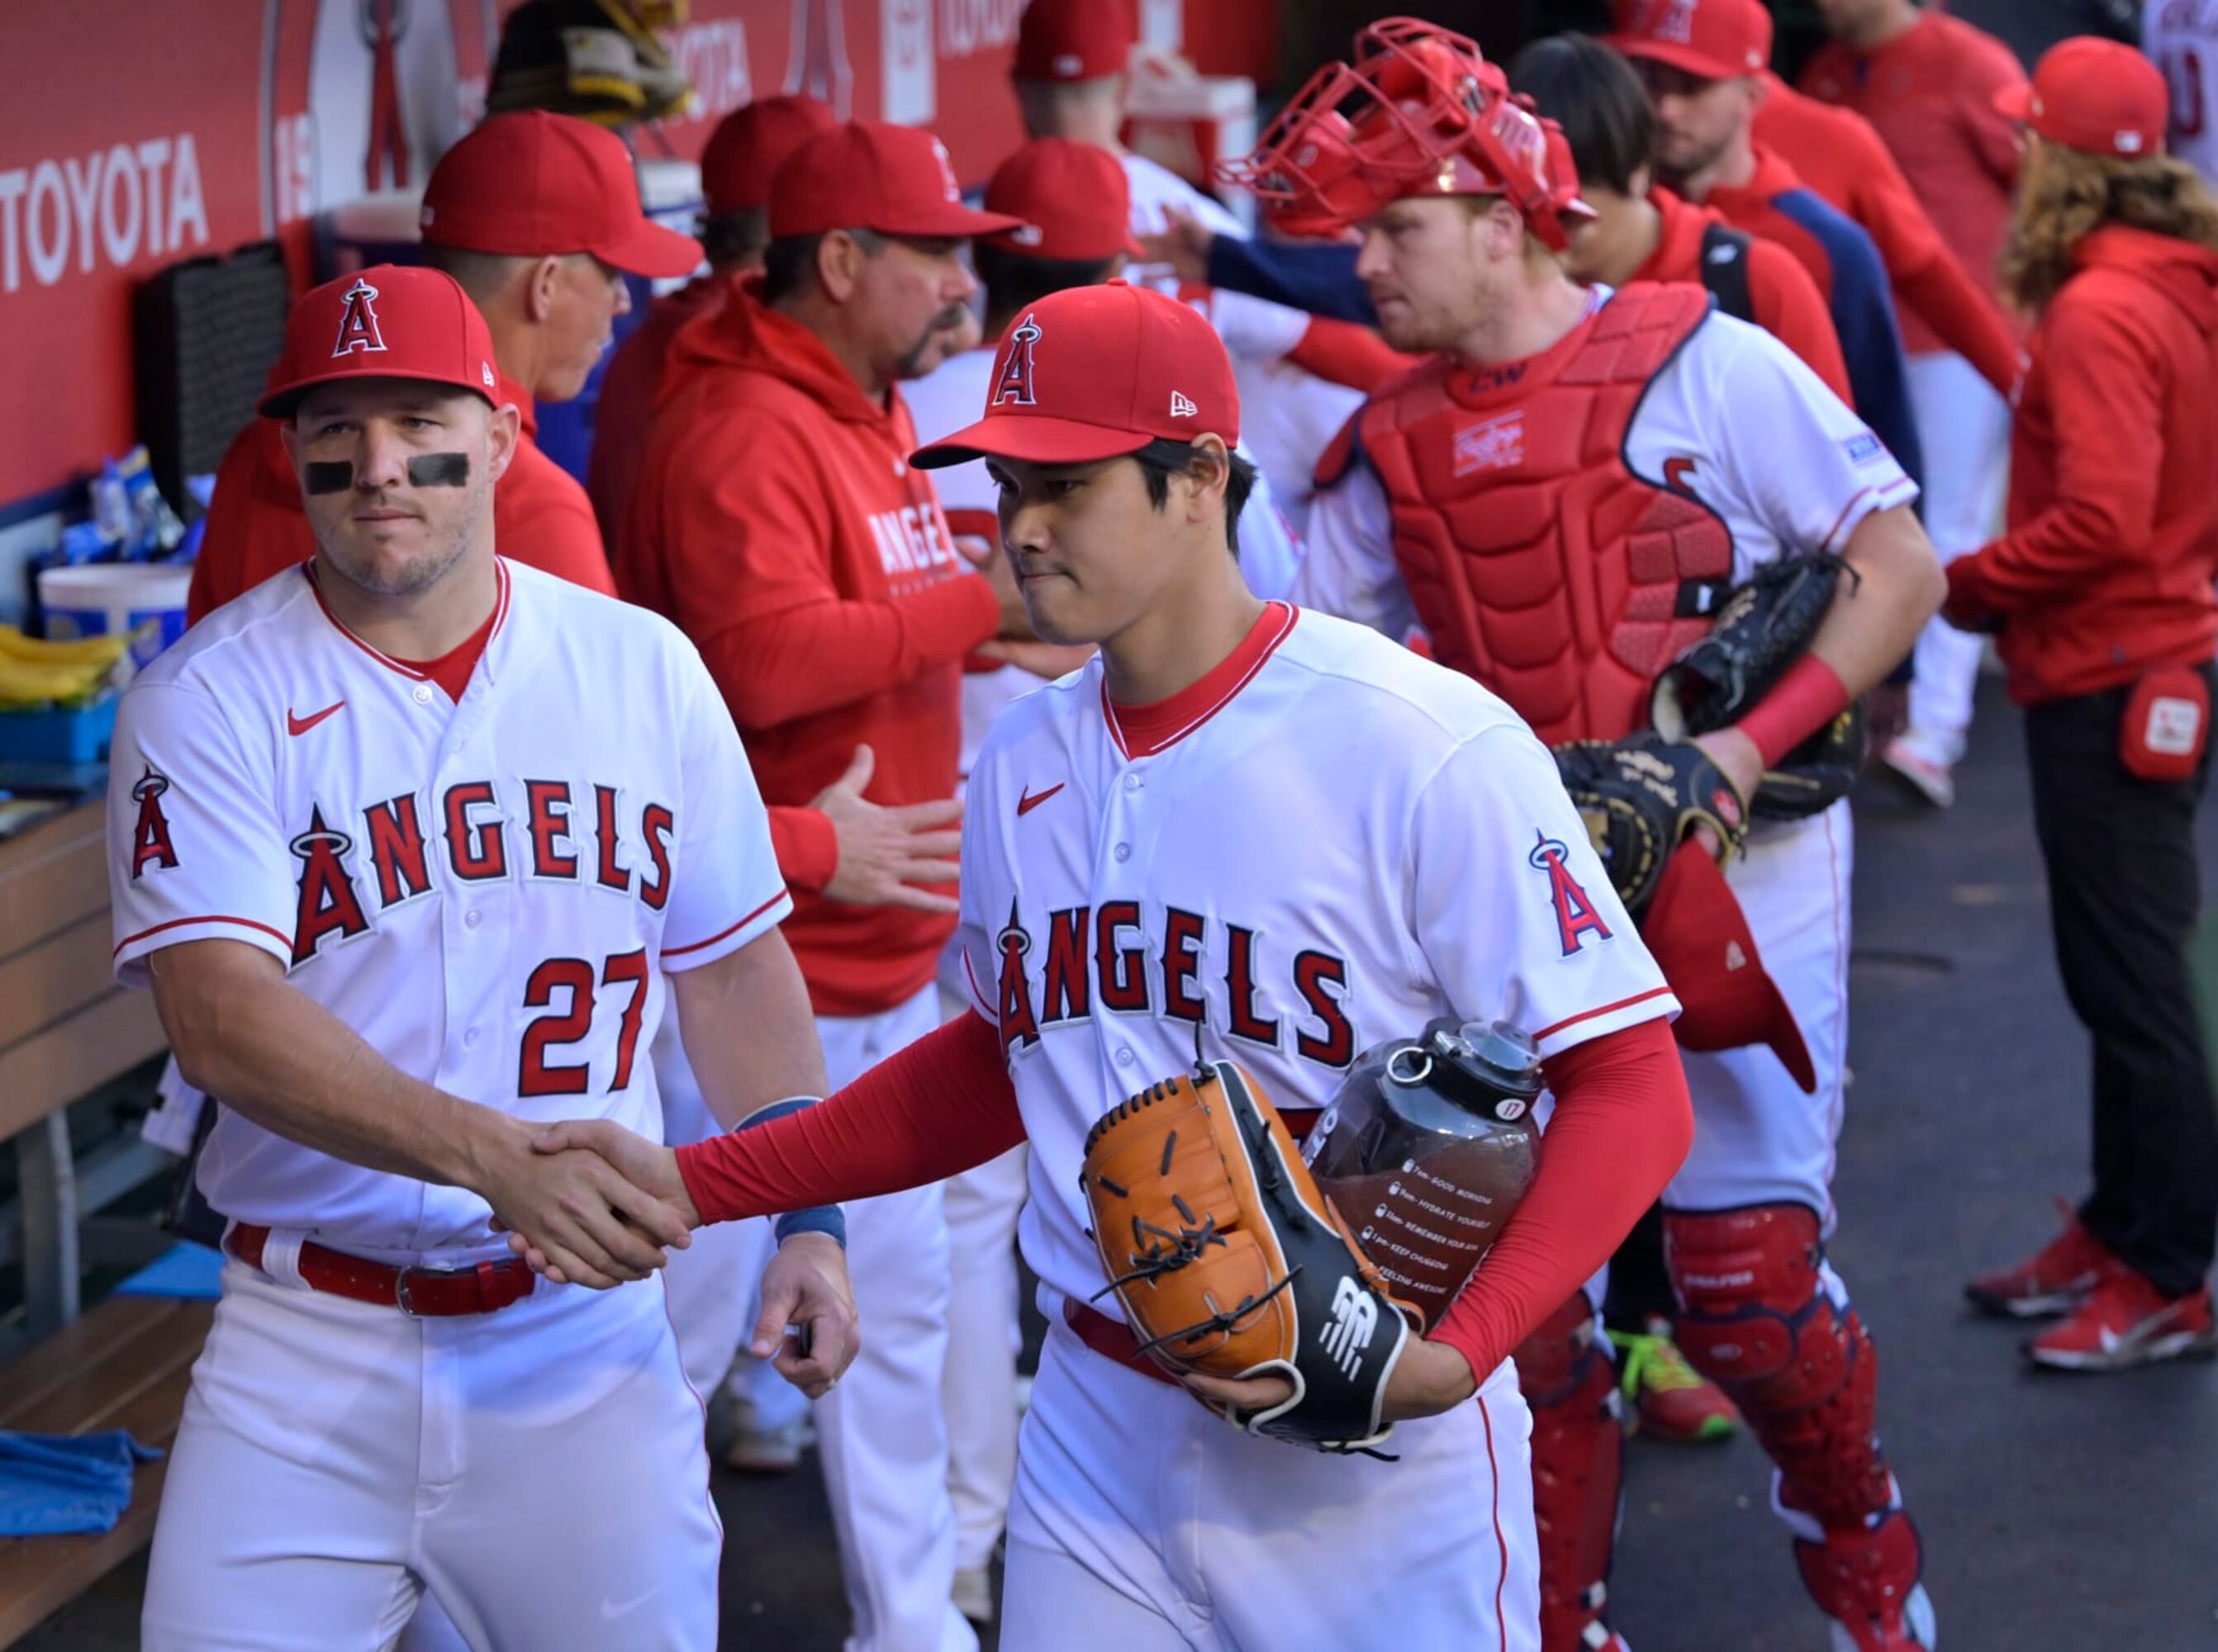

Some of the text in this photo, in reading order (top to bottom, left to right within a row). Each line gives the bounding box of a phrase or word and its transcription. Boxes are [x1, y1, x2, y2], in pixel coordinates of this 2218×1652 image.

[0, 132, 210, 292] TOYOTA
[331, 278, 388, 358] A
[991, 313, 1042, 406] A
[131, 764, 181, 880] A
[289, 800, 675, 966] ANGELS
[1529, 828, 1613, 957] A
[517, 947, 648, 1098] 27
[996, 895, 1356, 1066] ANGELS
[1503, 1102, 1521, 1117] 17
